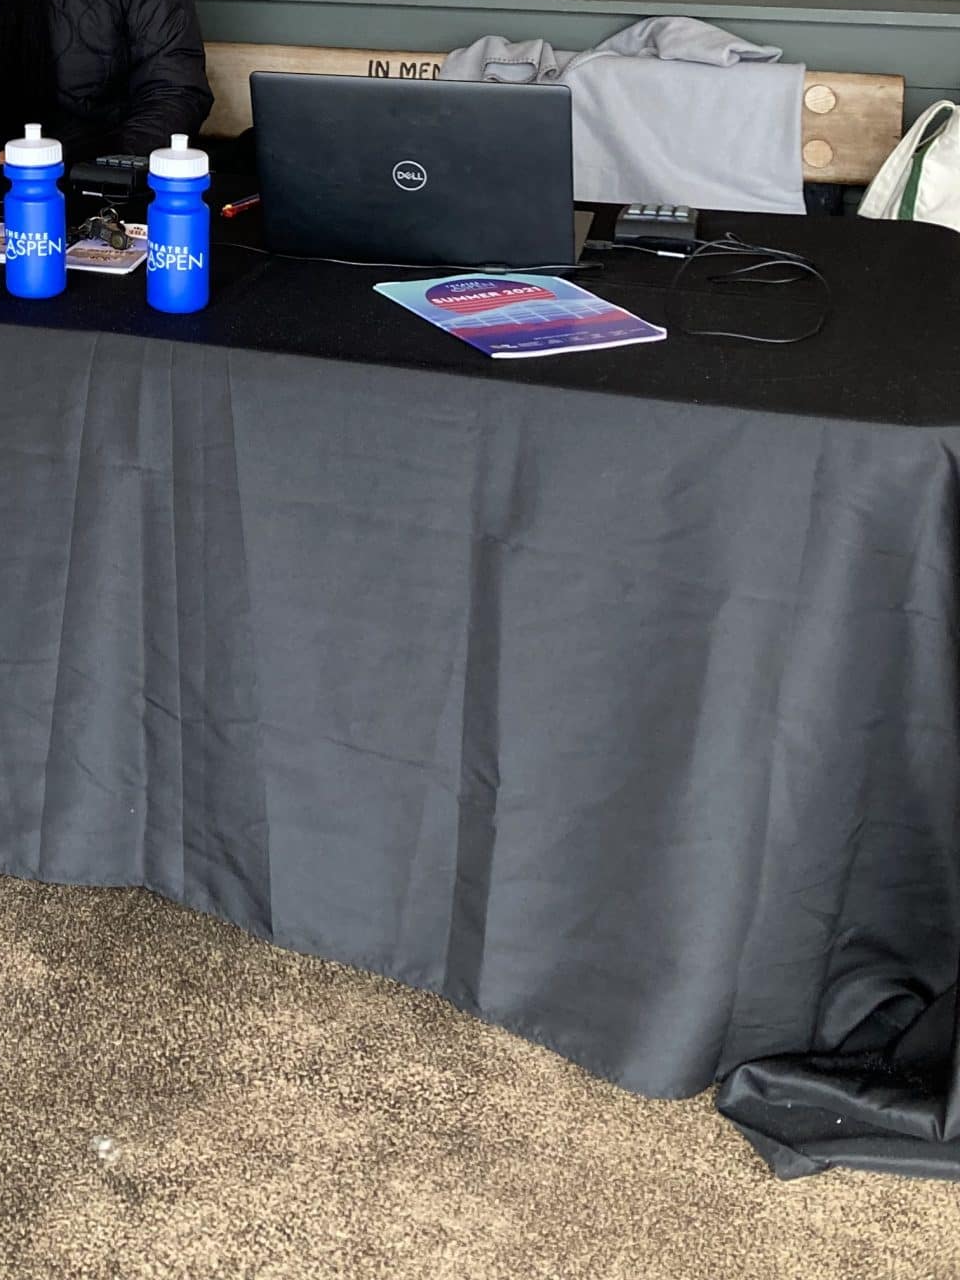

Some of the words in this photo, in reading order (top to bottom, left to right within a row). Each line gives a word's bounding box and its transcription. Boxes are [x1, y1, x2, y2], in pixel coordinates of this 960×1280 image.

[368, 58, 390, 78] IN
[397, 171, 424, 180] DELL
[7, 238, 62, 256] ASPEN
[149, 250, 202, 270] ASPEN
[432, 291, 501, 304] SUMMER
[503, 286, 542, 296] 2021
